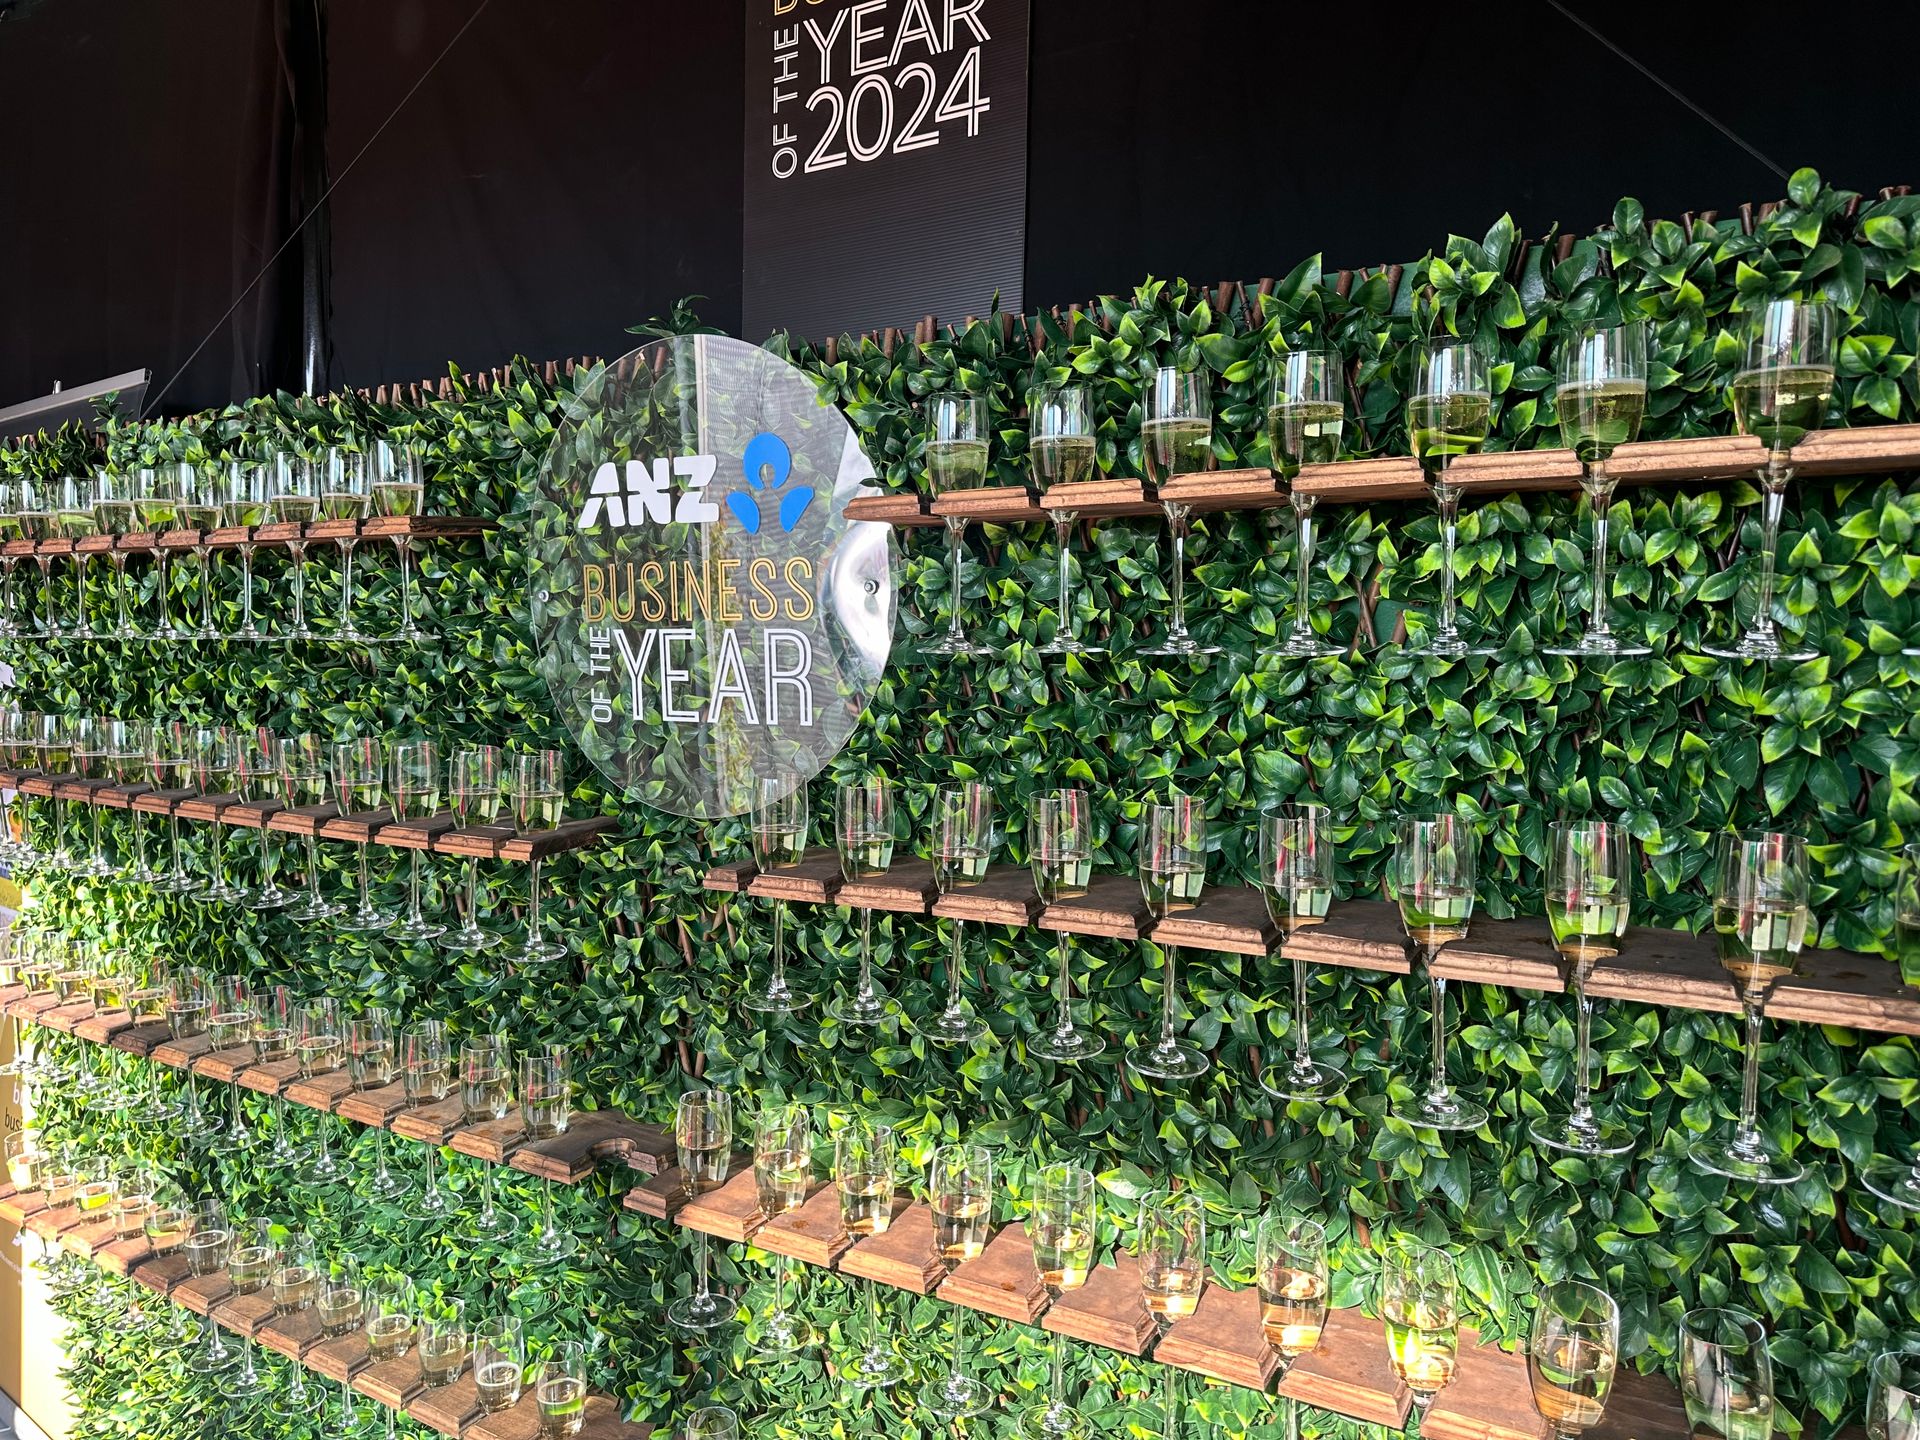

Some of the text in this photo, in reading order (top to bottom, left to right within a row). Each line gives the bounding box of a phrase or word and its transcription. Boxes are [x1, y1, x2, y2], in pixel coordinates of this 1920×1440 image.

[803, 0, 991, 84] YEAR
[772, 23, 799, 179] OF THE
[804, 46, 990, 174] 2024
[578, 455, 719, 528] ANZ
[584, 557, 814, 622] BUSINESS
[590, 626, 613, 723] OF THE
[614, 628, 813, 726] YEAR
